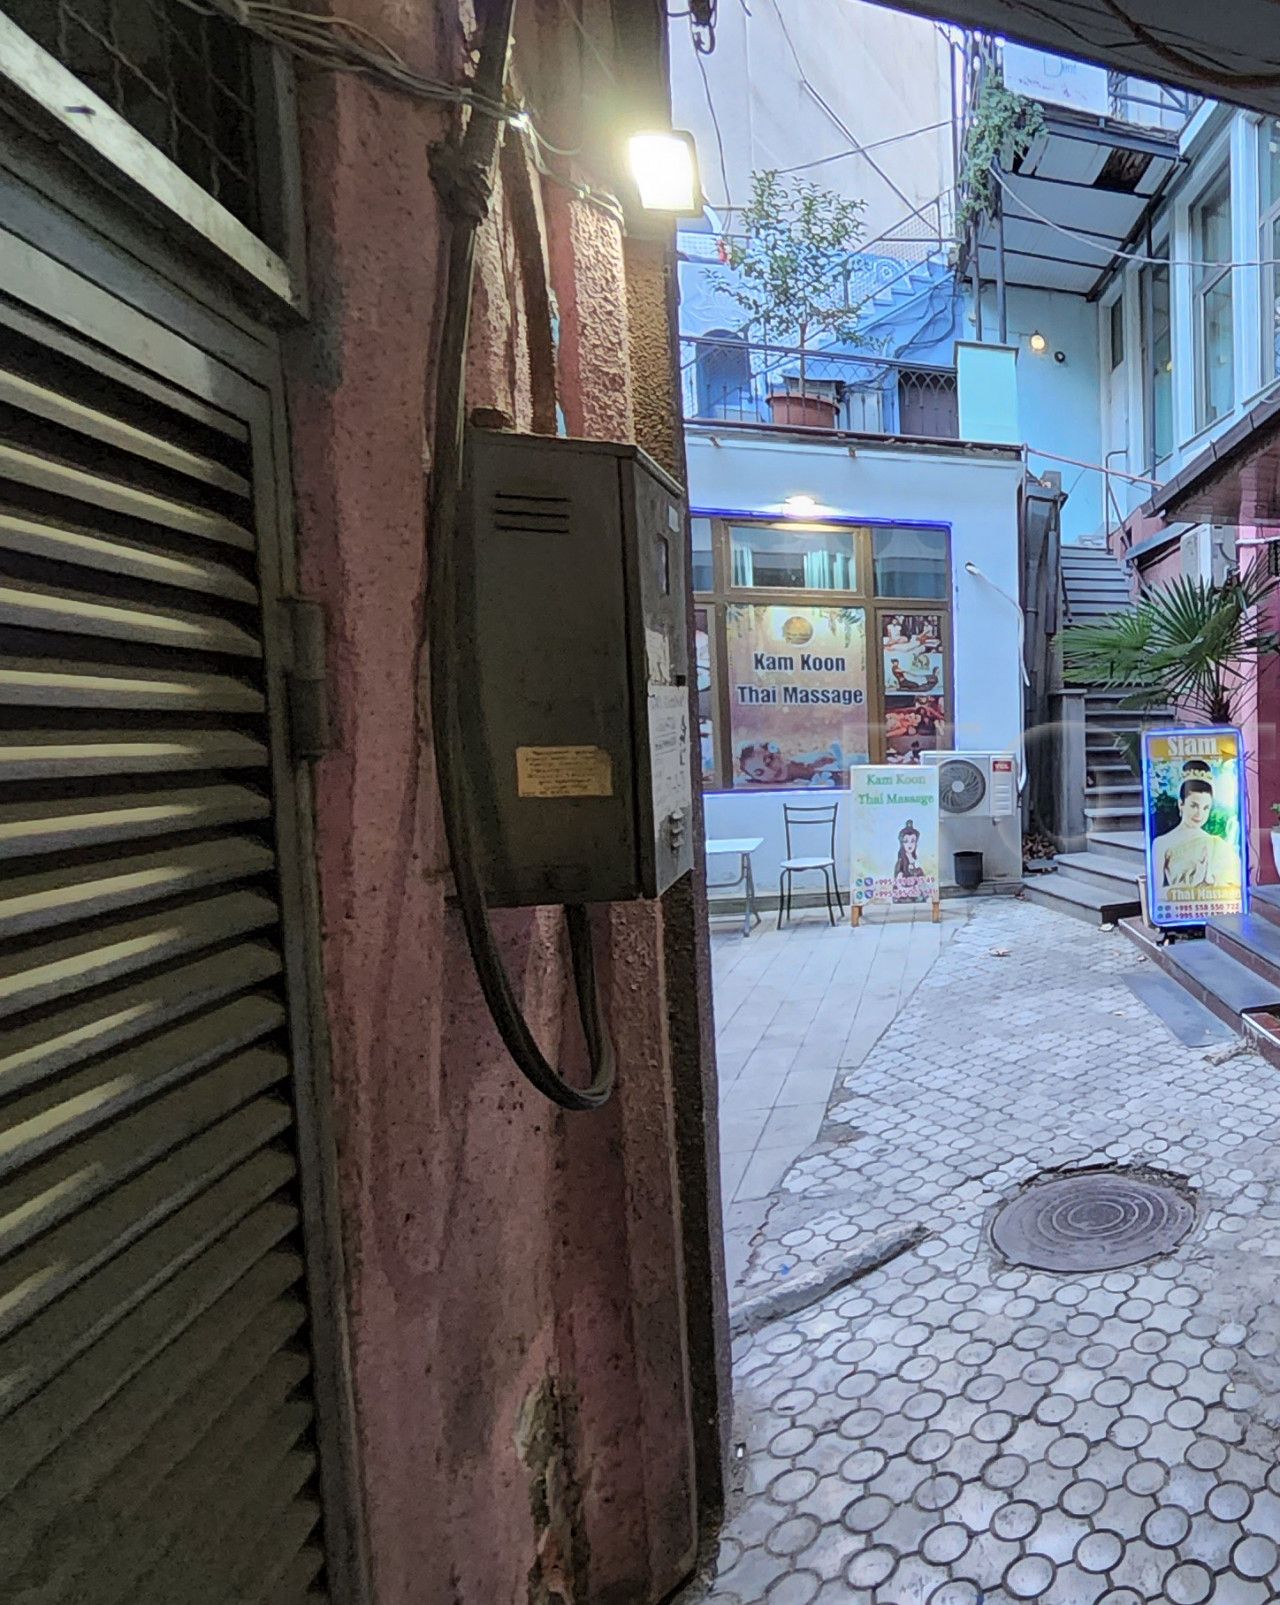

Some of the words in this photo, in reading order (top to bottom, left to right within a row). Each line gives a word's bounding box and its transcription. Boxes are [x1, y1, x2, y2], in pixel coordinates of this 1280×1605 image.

[753, 652, 794, 671] Kam
[801, 653, 846, 671] Koon
[737, 685, 776, 703] Thai
[783, 686, 863, 705] Massage
[1167, 735, 1218, 756] Siam
[867, 773, 893, 786] Kam
[896, 773, 926, 785] Koon
[858, 792, 884, 805] Thai
[886, 793, 934, 806] Massage
